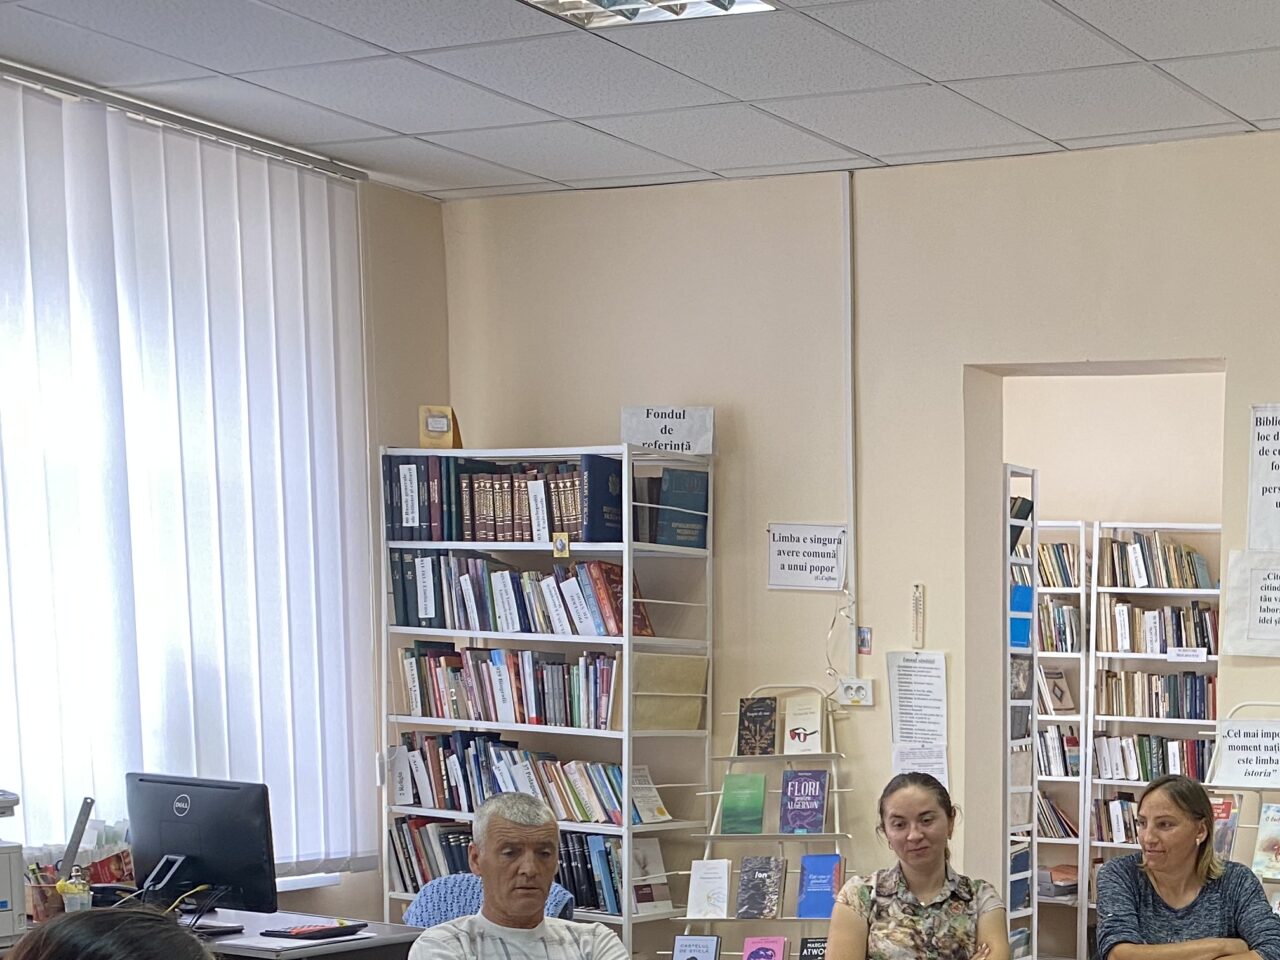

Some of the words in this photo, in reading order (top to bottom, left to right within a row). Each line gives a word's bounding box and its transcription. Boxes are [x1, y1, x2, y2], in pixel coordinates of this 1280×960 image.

[646, 408, 686, 420] Fondul
[660, 424, 674, 435] de
[1257, 432, 1271, 442] loc
[1258, 446, 1270, 456] de
[772, 532, 800, 543] Limba
[776, 549, 800, 557] avere
[802, 550, 837, 559] comună
[787, 562, 807, 572] unui
[809, 565, 835, 575] popor
[499, 678, 507, 704] Biografii
[1222, 729, 1242, 740] „Cel
[1243, 730, 1259, 739] mai
[1228, 744, 1262, 752] moment
[1238, 757, 1254, 766] este
[1256, 755, 1280, 765] limba
[787, 781, 820, 796] FLORI
[787, 801, 819, 810] ALGERNON
[754, 871, 767, 879] Ion
